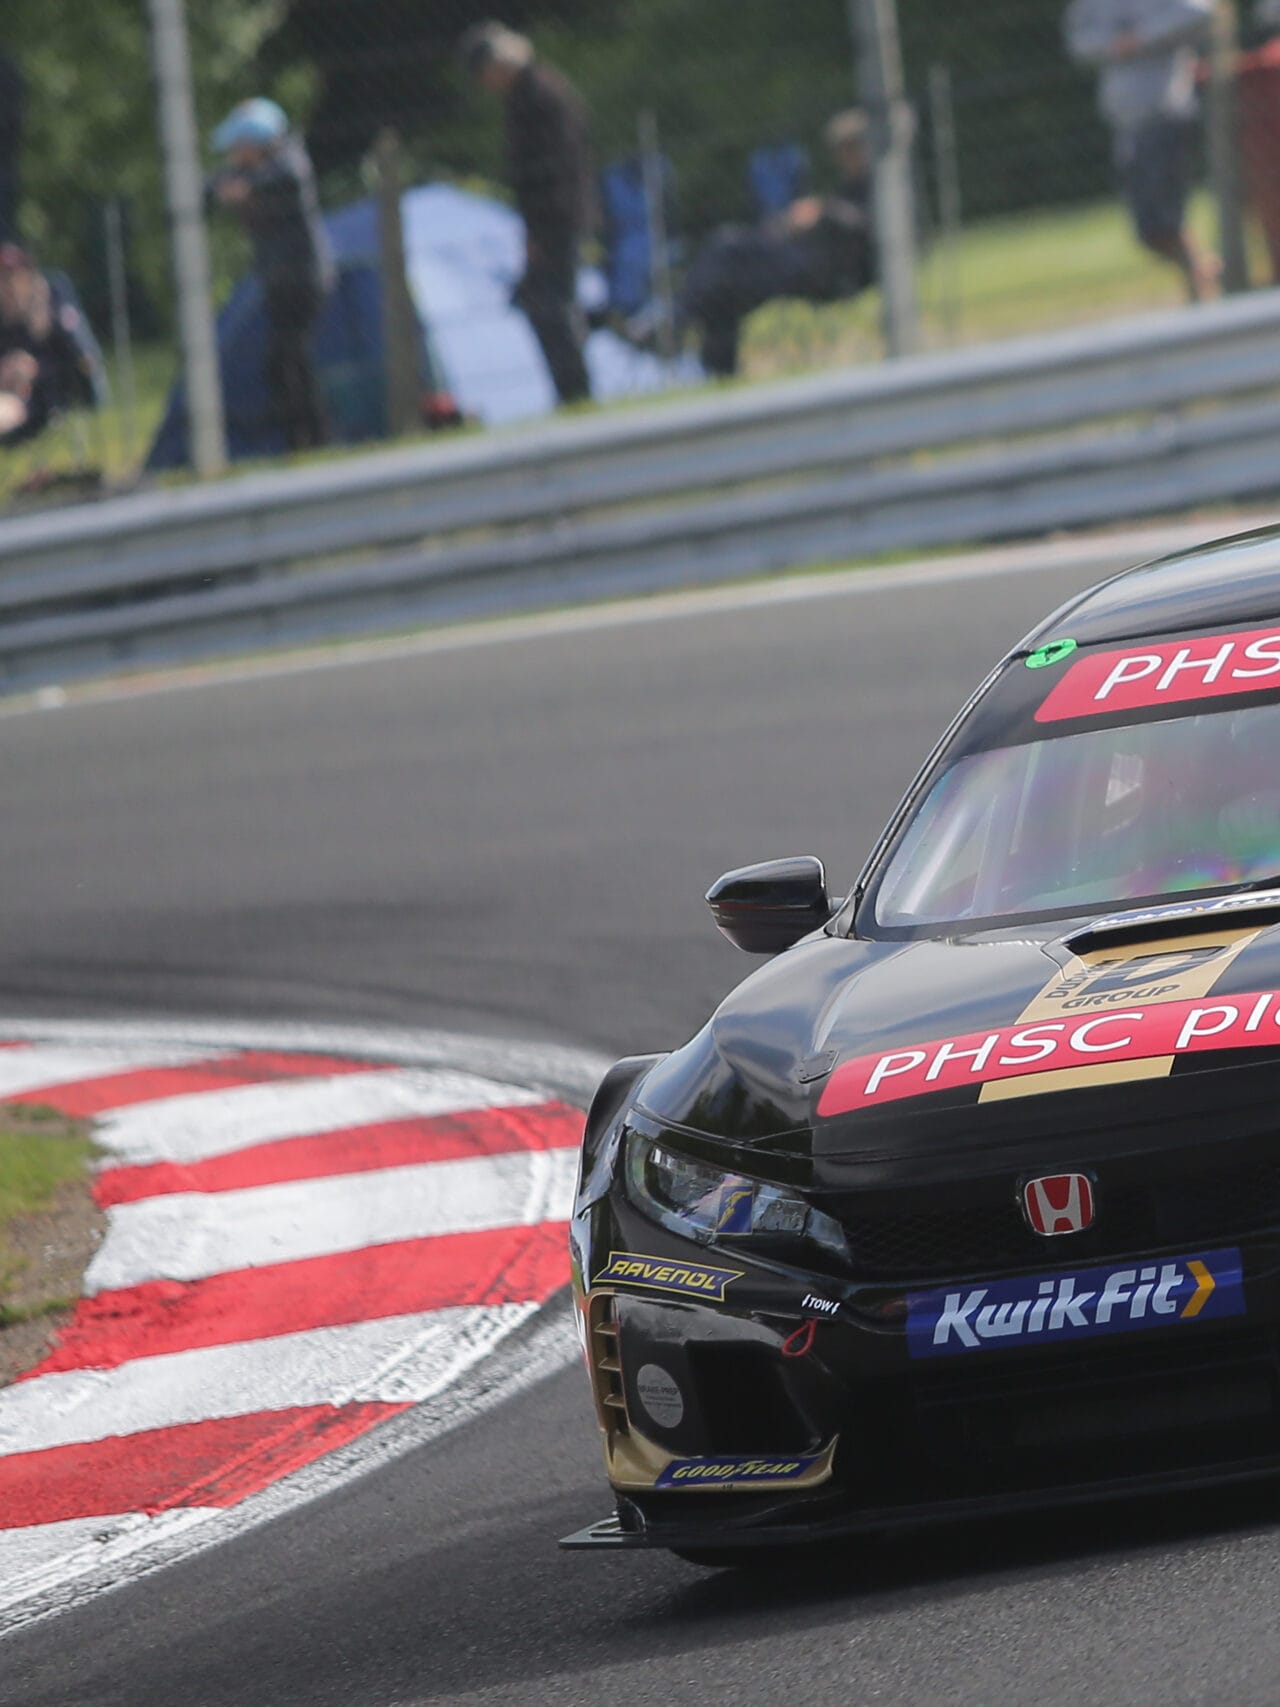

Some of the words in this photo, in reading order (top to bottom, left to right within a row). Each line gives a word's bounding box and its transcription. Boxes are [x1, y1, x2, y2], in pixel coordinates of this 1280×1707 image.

[1060, 983, 1181, 1009] GROUP
[863, 1012, 1144, 1095] PHSC
[608, 1260, 718, 1290] RAVENOL
[808, 1296, 834, 1312] TOW
[672, 1459, 801, 1480] GOODYEAR
